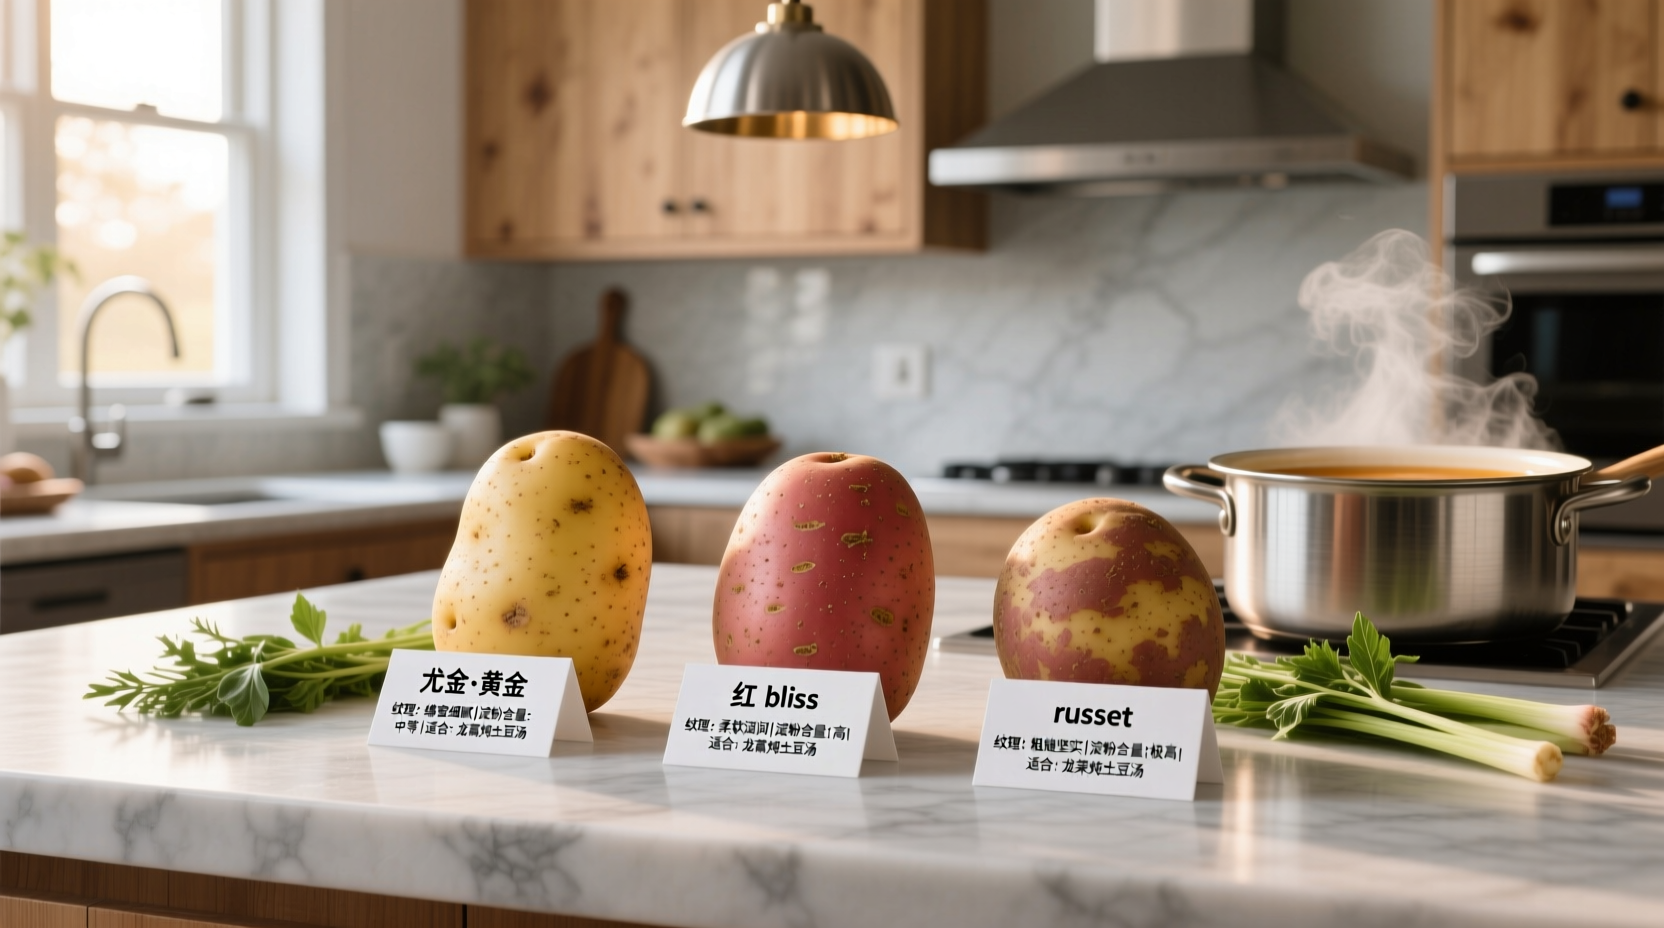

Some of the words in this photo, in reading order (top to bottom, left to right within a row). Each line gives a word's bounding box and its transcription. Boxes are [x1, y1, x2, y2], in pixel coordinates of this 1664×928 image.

[420, 668, 528, 697] 尤金·黄金
[730, 682, 757, 707] 红
[765, 685, 818, 709] bliss
[1054, 706, 1133, 728] russet
